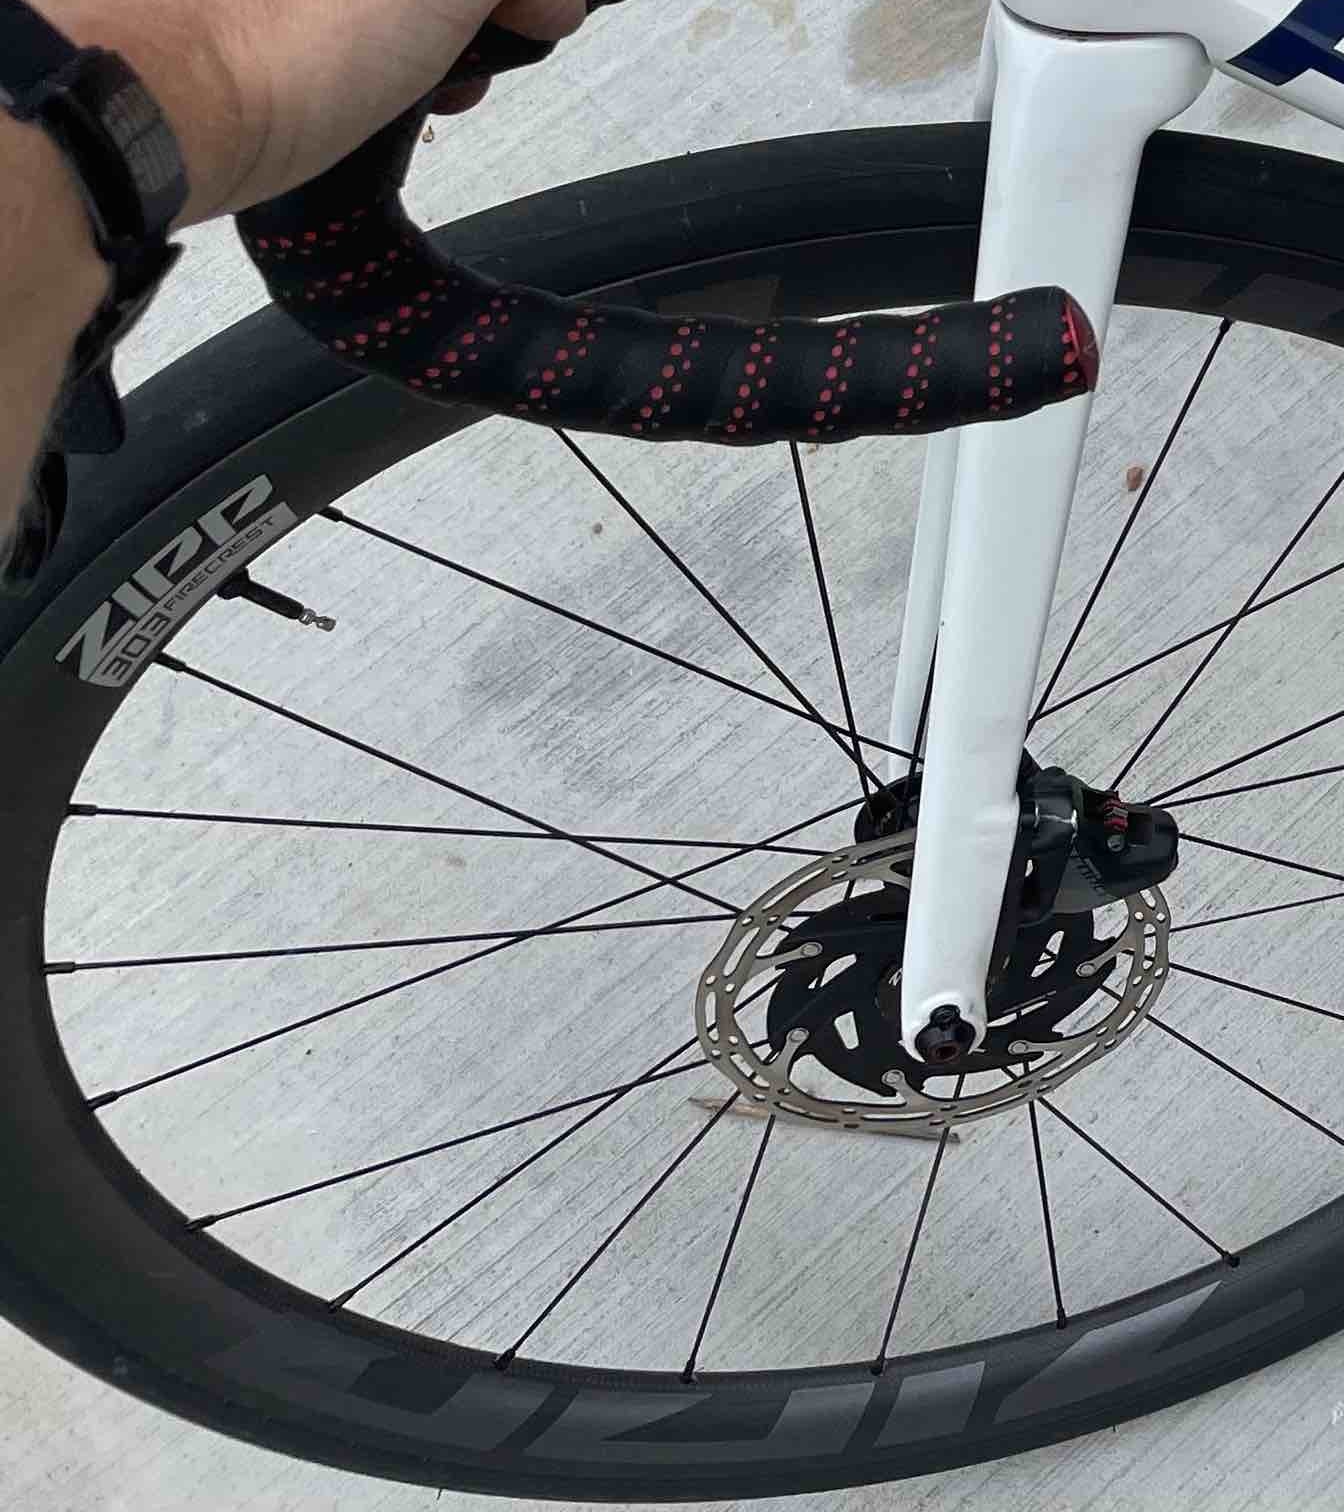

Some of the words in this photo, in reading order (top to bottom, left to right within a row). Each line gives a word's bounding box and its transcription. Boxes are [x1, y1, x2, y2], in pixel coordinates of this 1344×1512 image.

[55, 473, 274, 681] ZIPP
[100, 609, 173, 686] 303
[163, 518, 276, 614] FIRECREST
